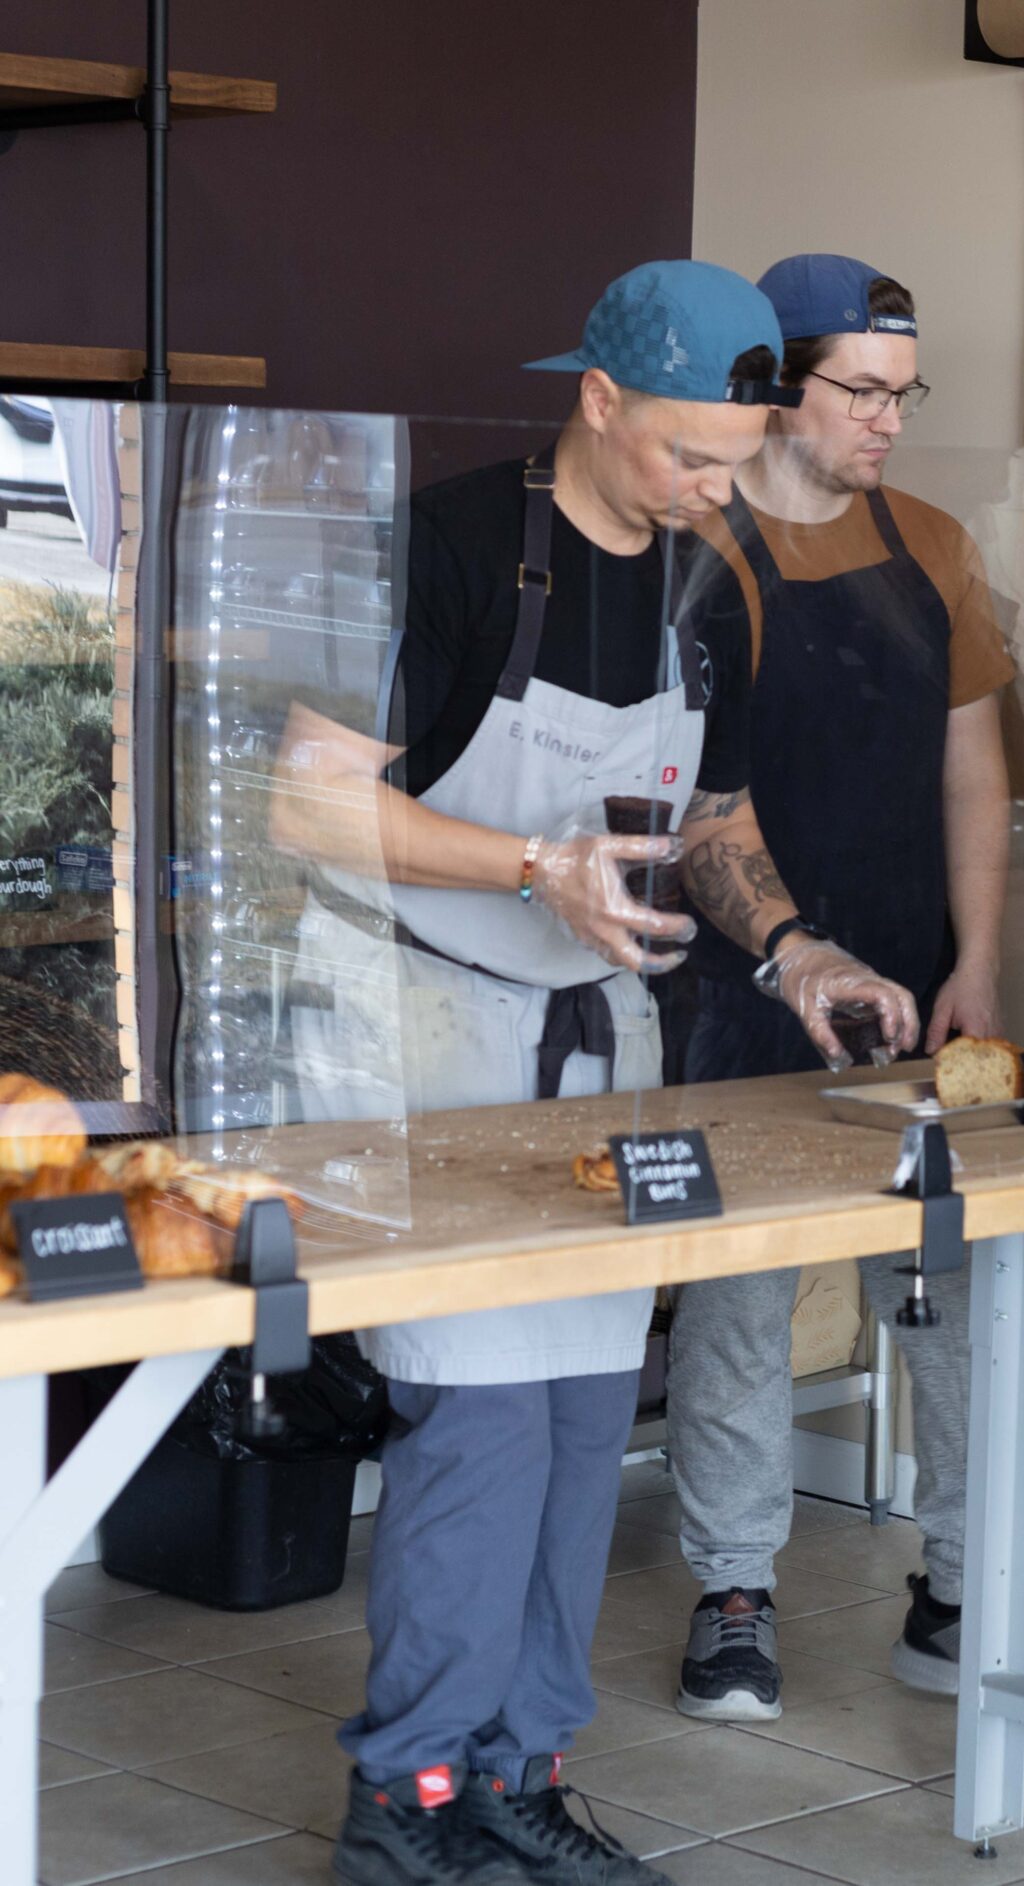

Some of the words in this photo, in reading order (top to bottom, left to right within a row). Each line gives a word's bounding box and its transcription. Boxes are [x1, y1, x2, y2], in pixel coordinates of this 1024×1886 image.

[532, 728, 602, 763] Kinsler
[0, 857, 46, 876] erything
[0, 877, 52, 899] urdough
